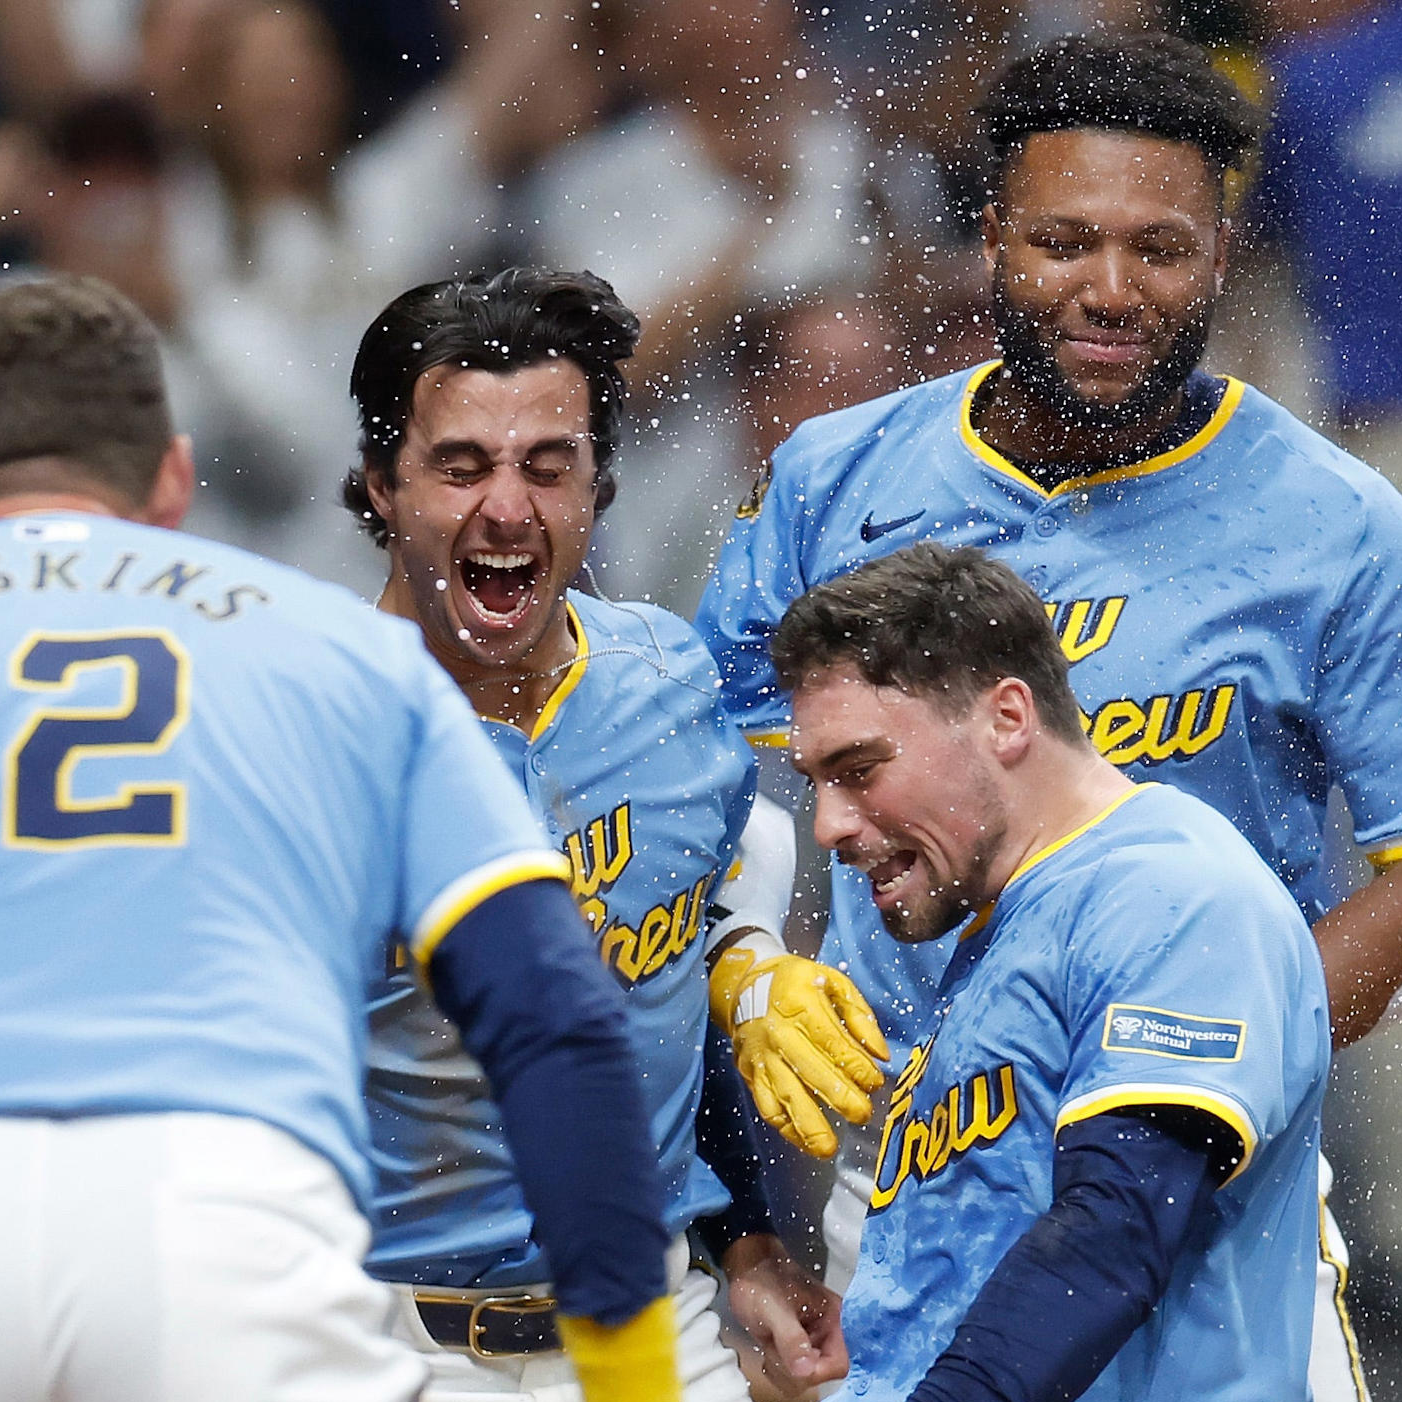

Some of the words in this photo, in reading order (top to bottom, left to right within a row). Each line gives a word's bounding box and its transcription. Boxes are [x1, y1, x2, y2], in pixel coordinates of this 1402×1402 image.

[576, 866, 718, 993] rew
[1141, 1030, 1192, 1050] Mutual
[1142, 1018, 1239, 1042] Northwestern
